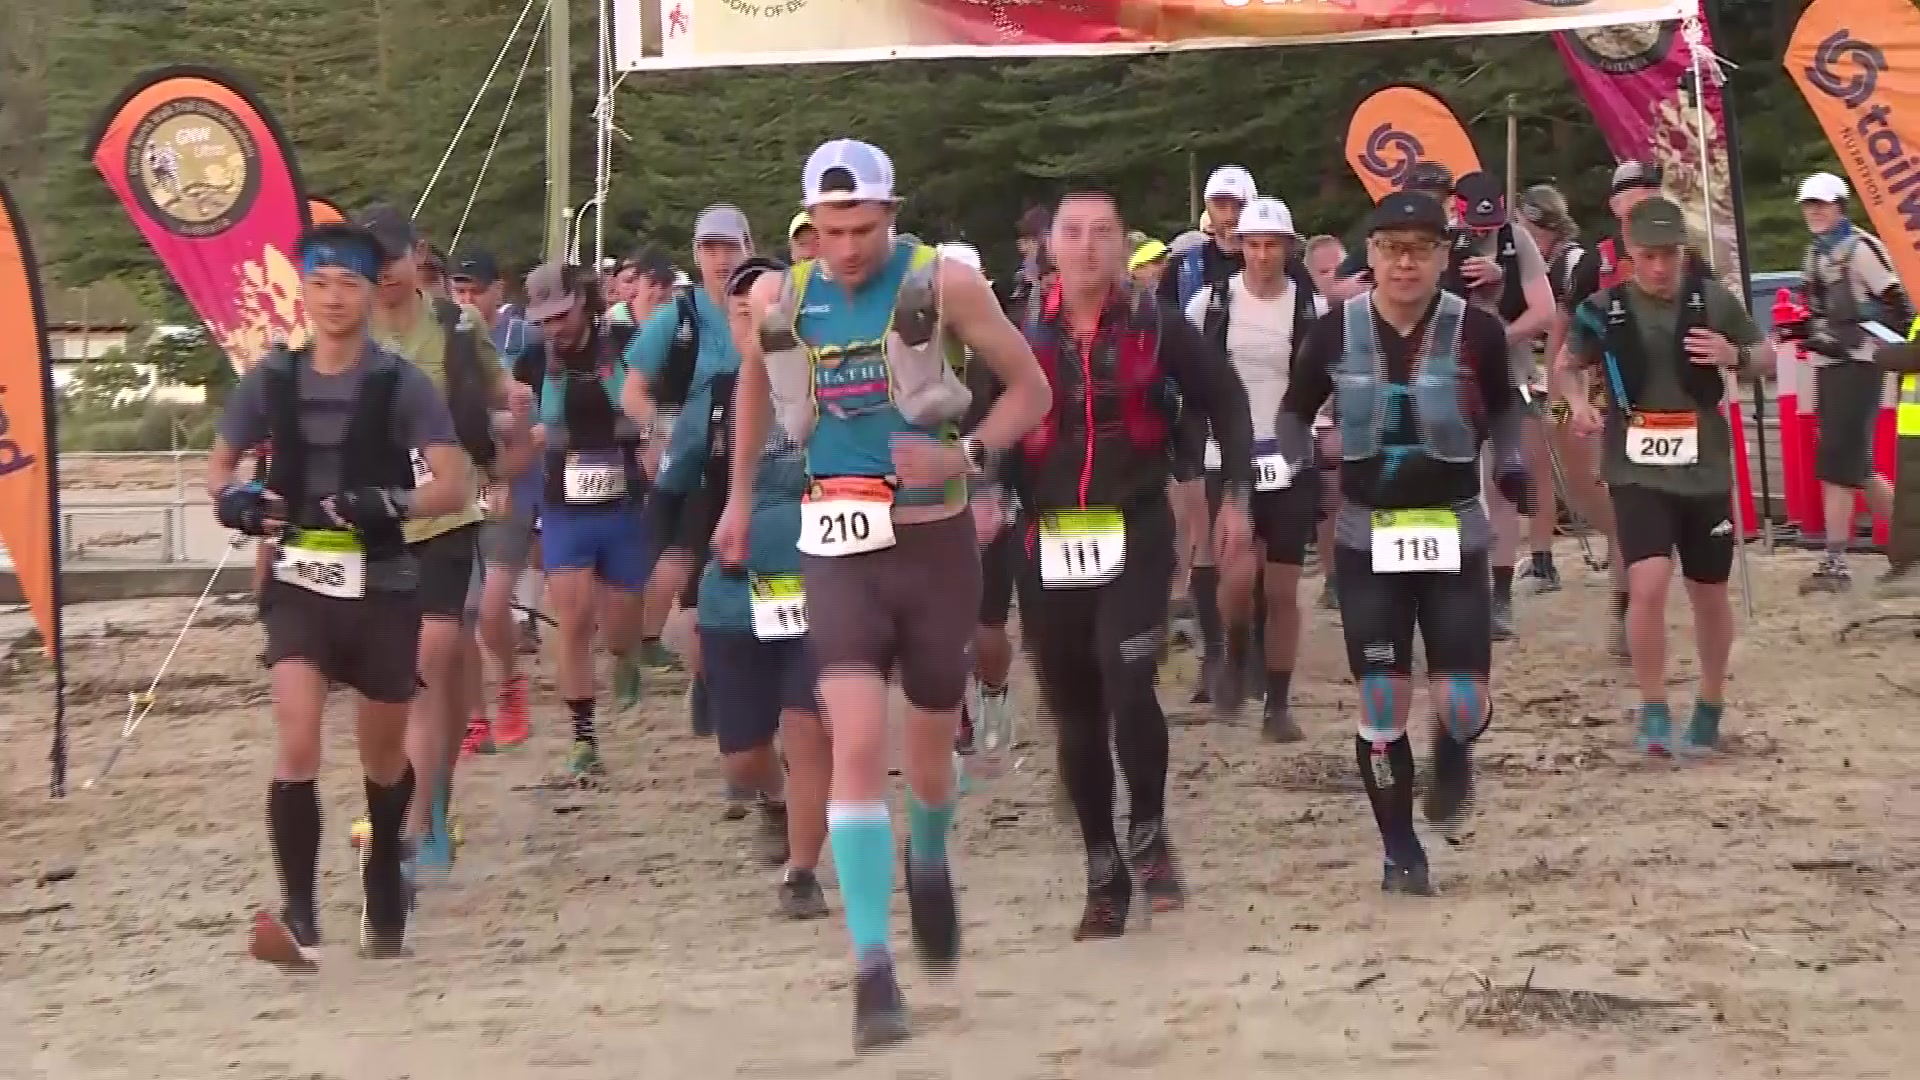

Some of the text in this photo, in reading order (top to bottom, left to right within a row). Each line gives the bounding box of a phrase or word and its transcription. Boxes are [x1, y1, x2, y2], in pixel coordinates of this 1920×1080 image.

[722, 0, 760, 17] ONY
[764, 6, 784, 18] OF
[175, 127, 210, 146] GNW
[1857, 104, 1920, 250] tailw
[1640, 437, 1683, 457] 207
[577, 471, 616, 496] 303
[819, 511, 870, 544] 210
[1060, 538, 1101, 576] 111
[1392, 536, 1440, 561] 118
[292, 558, 347, 588] 108
